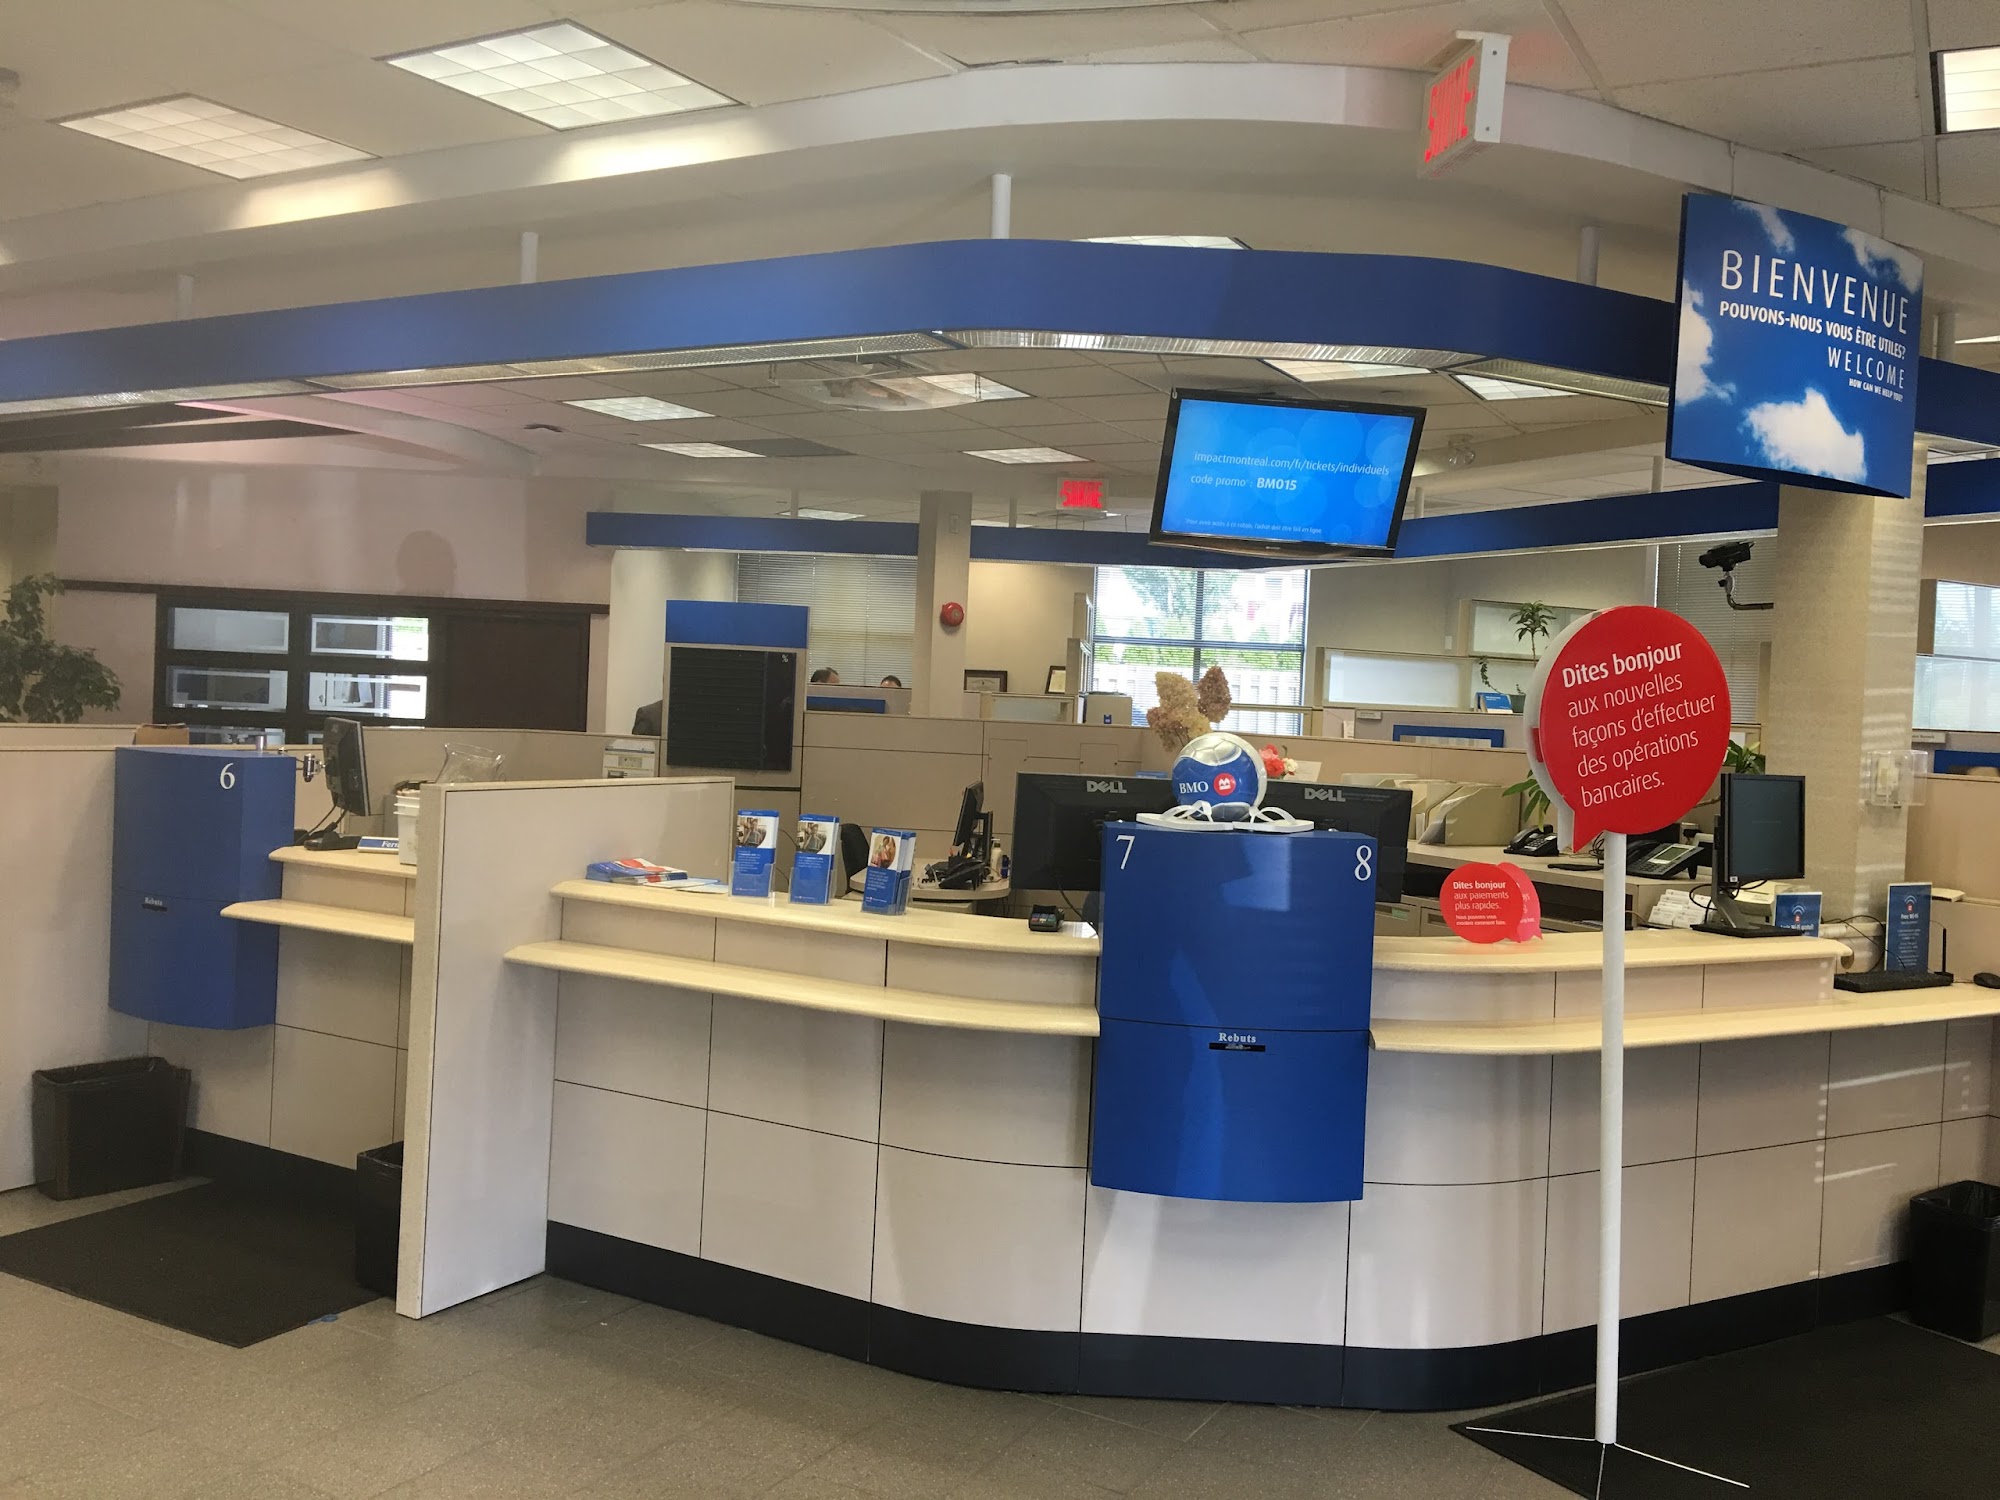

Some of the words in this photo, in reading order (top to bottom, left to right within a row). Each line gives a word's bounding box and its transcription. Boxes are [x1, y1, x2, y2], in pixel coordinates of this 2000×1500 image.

[1721, 249, 1909, 335] BIENVENUE
[1719, 300, 1823, 334] POUVONS-NOUS
[1825, 320, 1853, 342] VOUS
[1855, 326, 1877, 349] ÊTRE
[1878, 336, 1906, 360] UTILES?
[1828, 346, 1905, 389] WELCOME
[1849, 377, 1862, 389] HOW
[1862, 382, 1874, 392] CAN
[1874, 385, 1882, 395] WE
[1882, 388, 1893, 398] HELP
[1194, 452, 1390, 476] impactmontreal.com/fr/tickets/individuels
[1190, 474, 1213, 485] code
[1562, 662, 1609, 688] Dites
[1612, 642, 1682, 676] bonjour
[1568, 696, 1599, 718] aux
[1604, 672, 1683, 708] nouvelles
[1572, 719, 1626, 748] façons
[1631, 694, 1716, 732] d'effectuer
[1577, 754, 1608, 778] des
[1612, 730, 1699, 771] opérations
[220, 762, 236, 790] 6
[1086, 780, 1127, 794] DELL
[1179, 781, 1208, 794] BMO
[1580, 771, 1665, 808] bancaires.
[1304, 788, 1346, 802] DELL
[1116, 835, 1135, 870] 7
[1354, 845, 1372, 881] 8
[1453, 882, 1473, 890] Dites
[1475, 880, 1506, 890] bonjour
[1470, 891, 1509, 901] paiements
[1455, 902, 1470, 911] plus
[1472, 901, 1501, 911] rapides.
[1218, 1032, 1256, 1043] Rebuts
